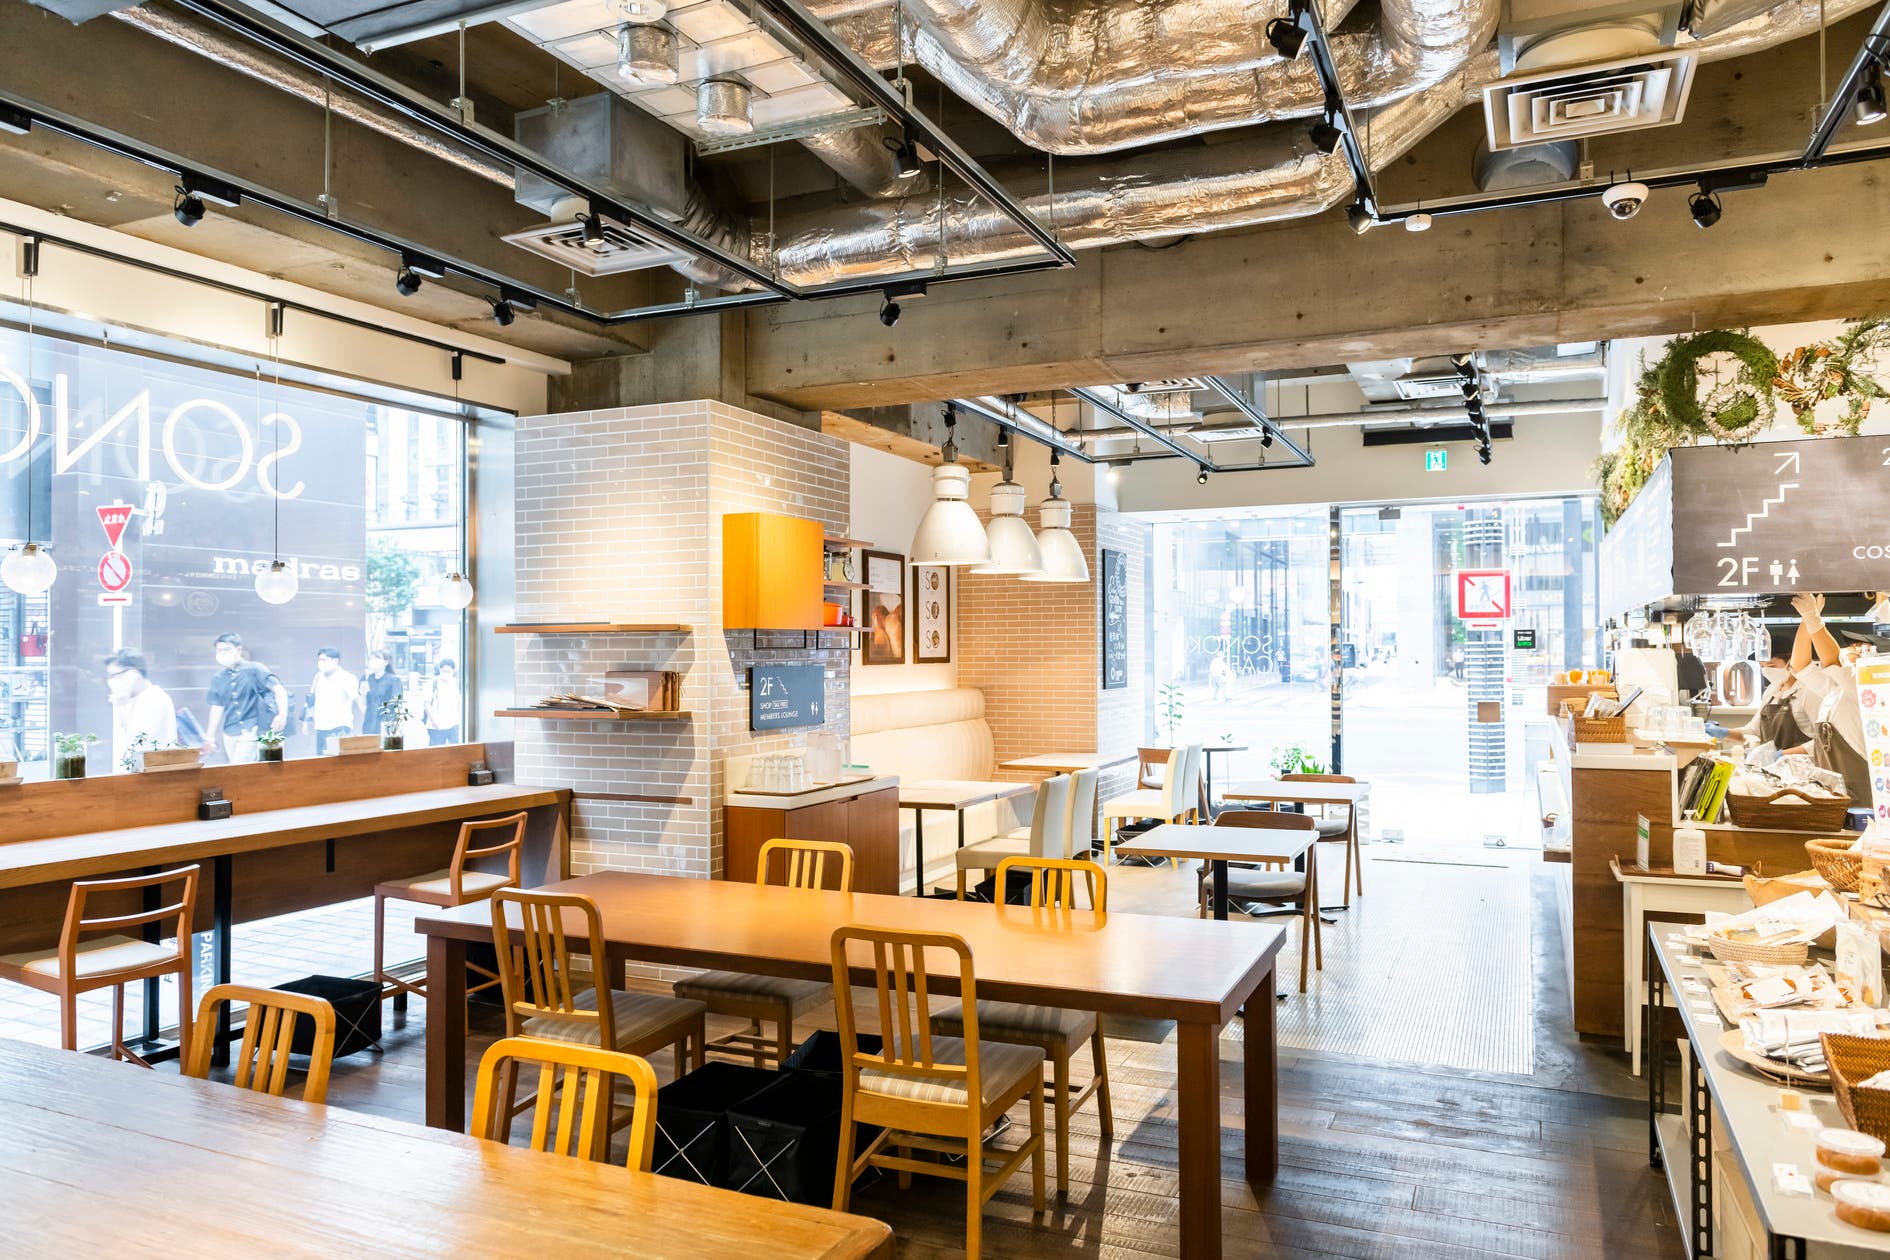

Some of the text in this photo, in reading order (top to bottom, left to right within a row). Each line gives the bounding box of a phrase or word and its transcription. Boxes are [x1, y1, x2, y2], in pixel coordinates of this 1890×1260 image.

[213, 556, 361, 581] madras
[1717, 556, 1760, 587] 2F
[760, 677, 773, 696] 2F
[760, 710, 799, 720] MEMBERS LOUNGE
